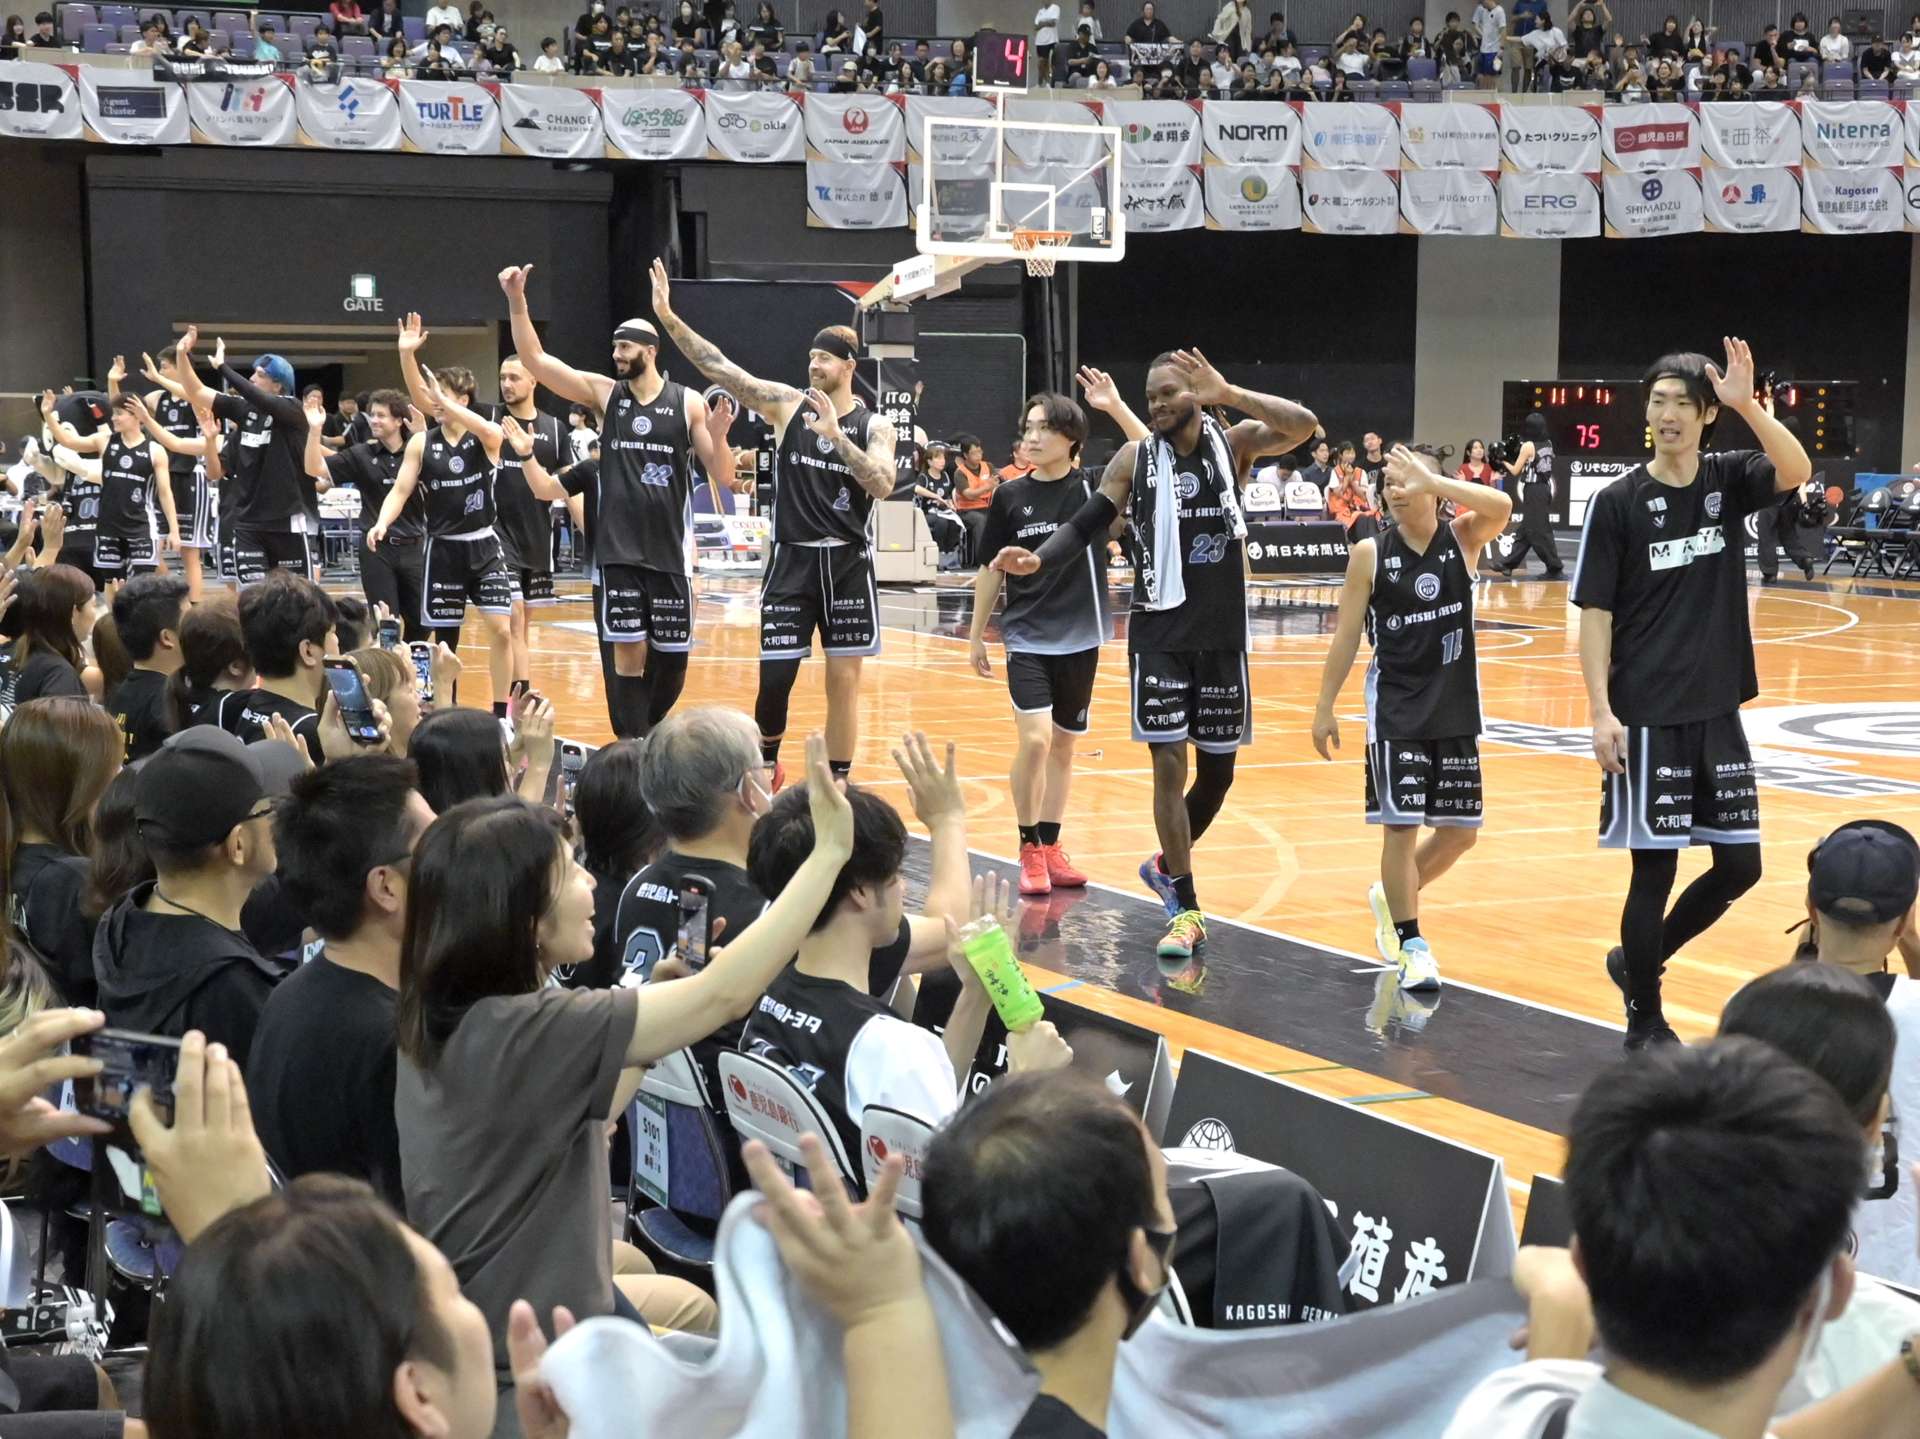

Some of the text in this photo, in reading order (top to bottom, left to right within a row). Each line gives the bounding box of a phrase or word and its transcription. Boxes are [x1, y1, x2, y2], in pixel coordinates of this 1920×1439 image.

[1005, 39, 1025, 77] 4
[416, 96, 483, 122] TURTLE
[547, 113, 593, 125] CHANGE
[1219, 124, 1287, 141] NORM
[1524, 132, 1597, 143] たついクリニック
[1638, 131, 1684, 144] 鹿児島日産
[1817, 123, 1890, 139] Niterra
[1835, 185, 1878, 198] Kagosen
[1524, 195, 1577, 209] ERG
[1625, 201, 1681, 214] SHIMADZU
[343, 297, 384, 312] GATE
[885, 391, 912, 404] ITの
[1576, 425, 1600, 448] 75
[620, 441, 674, 454] NISHI SHUZO
[800, 455, 853, 475] NISHI SHUZ
[640, 462, 673, 487] 22
[833, 486, 850, 511] 2
[1195, 507, 1223, 518] SHUZ
[1189, 533, 1228, 564] 23
[1265, 543, 1348, 558] 南日本新聞社
[1404, 610, 1436, 626] NISHI
[749, 1090, 800, 1133] 鹿児島銀行
